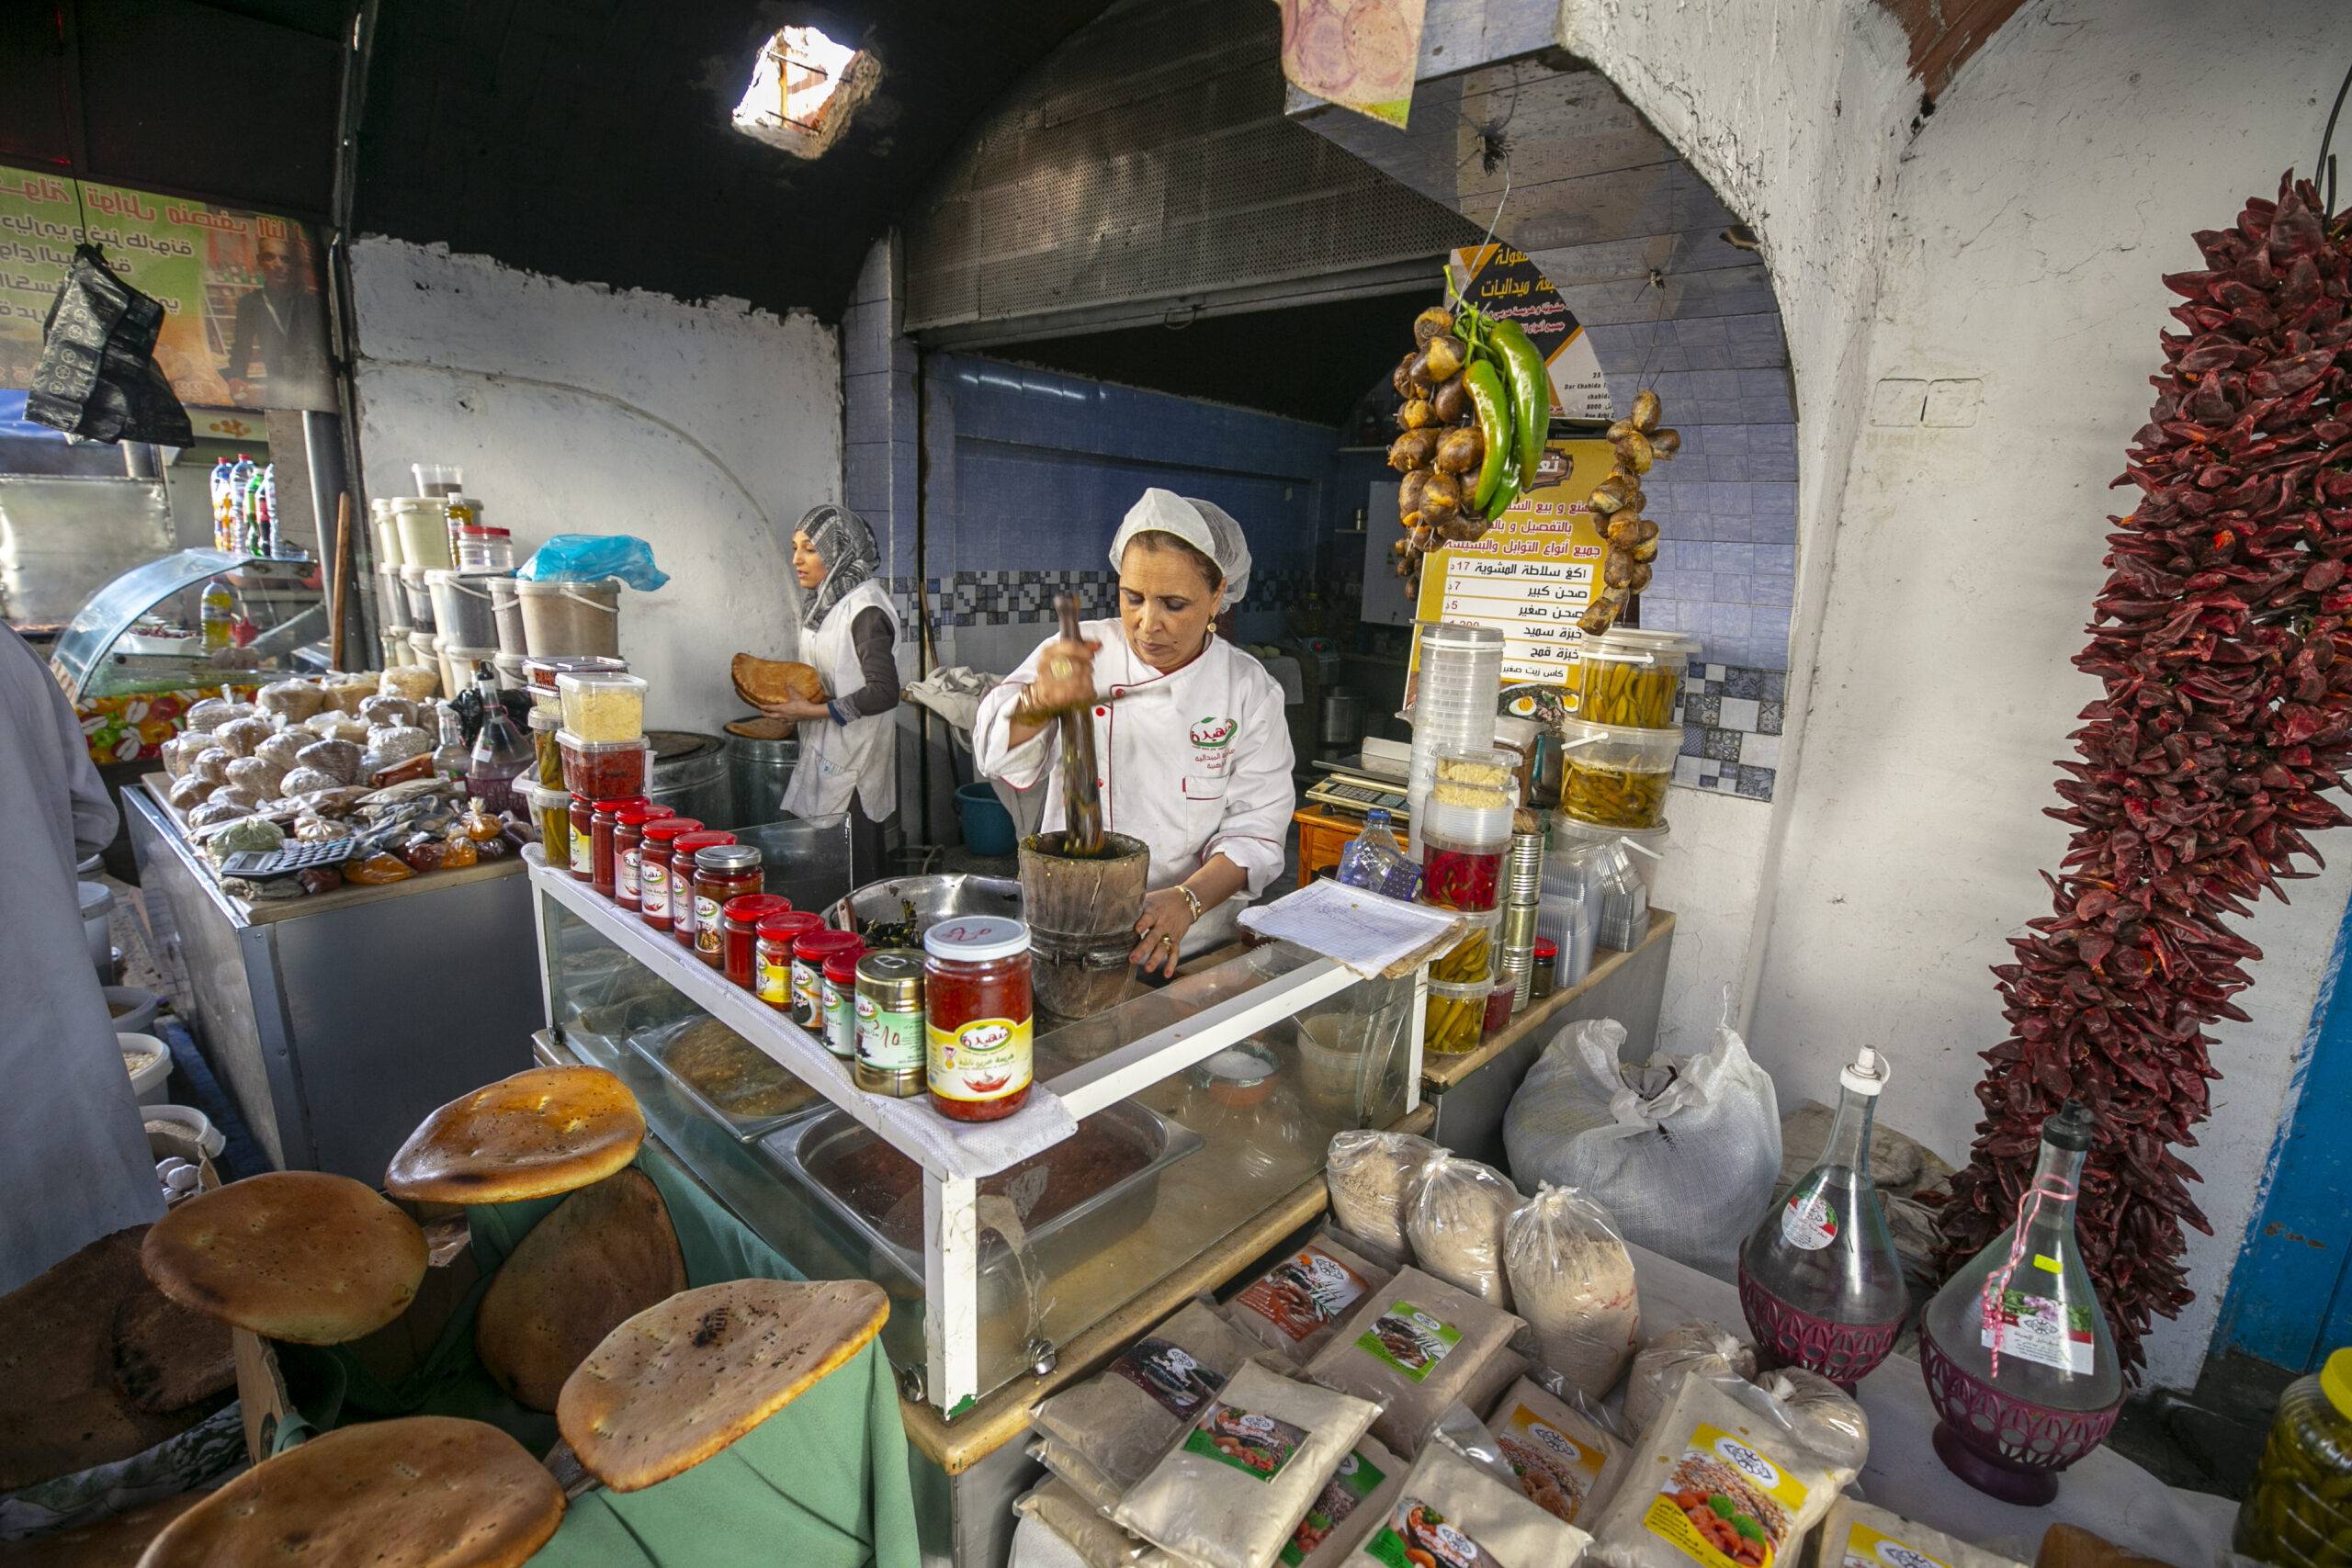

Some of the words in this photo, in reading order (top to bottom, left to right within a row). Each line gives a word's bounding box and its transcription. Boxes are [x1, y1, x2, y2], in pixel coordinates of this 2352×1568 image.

[1480, 277, 1530, 299] ميداليات
[1535, 502, 1553, 514] بيع
[1557, 502, 1565, 514] و
[1510, 521, 1517, 533] و
[1521, 519, 1573, 536] بالتفصيل
[1503, 540, 1538, 555] التوابل
[1543, 539, 1568, 556] أنواع
[1573, 547, 1602, 558] جميع
[1475, 561, 1517, 575] المشوية
[1521, 565, 1560, 577] سلاطة
[1527, 585, 1550, 598] كبير
[1555, 586, 1588, 599] صحن
[1451, 600, 1458, 610] 5
[1518, 604, 1547, 617] صغير
[1552, 605, 1584, 619] صحن
[1523, 626, 1555, 638] سميد
[1558, 626, 1582, 639] خبزة
[1530, 646, 1552, 658] قمح
[1555, 646, 1579, 660] خبزة
[1525, 666, 1541, 677] زيت
[1543, 666, 1564, 678] كأس
